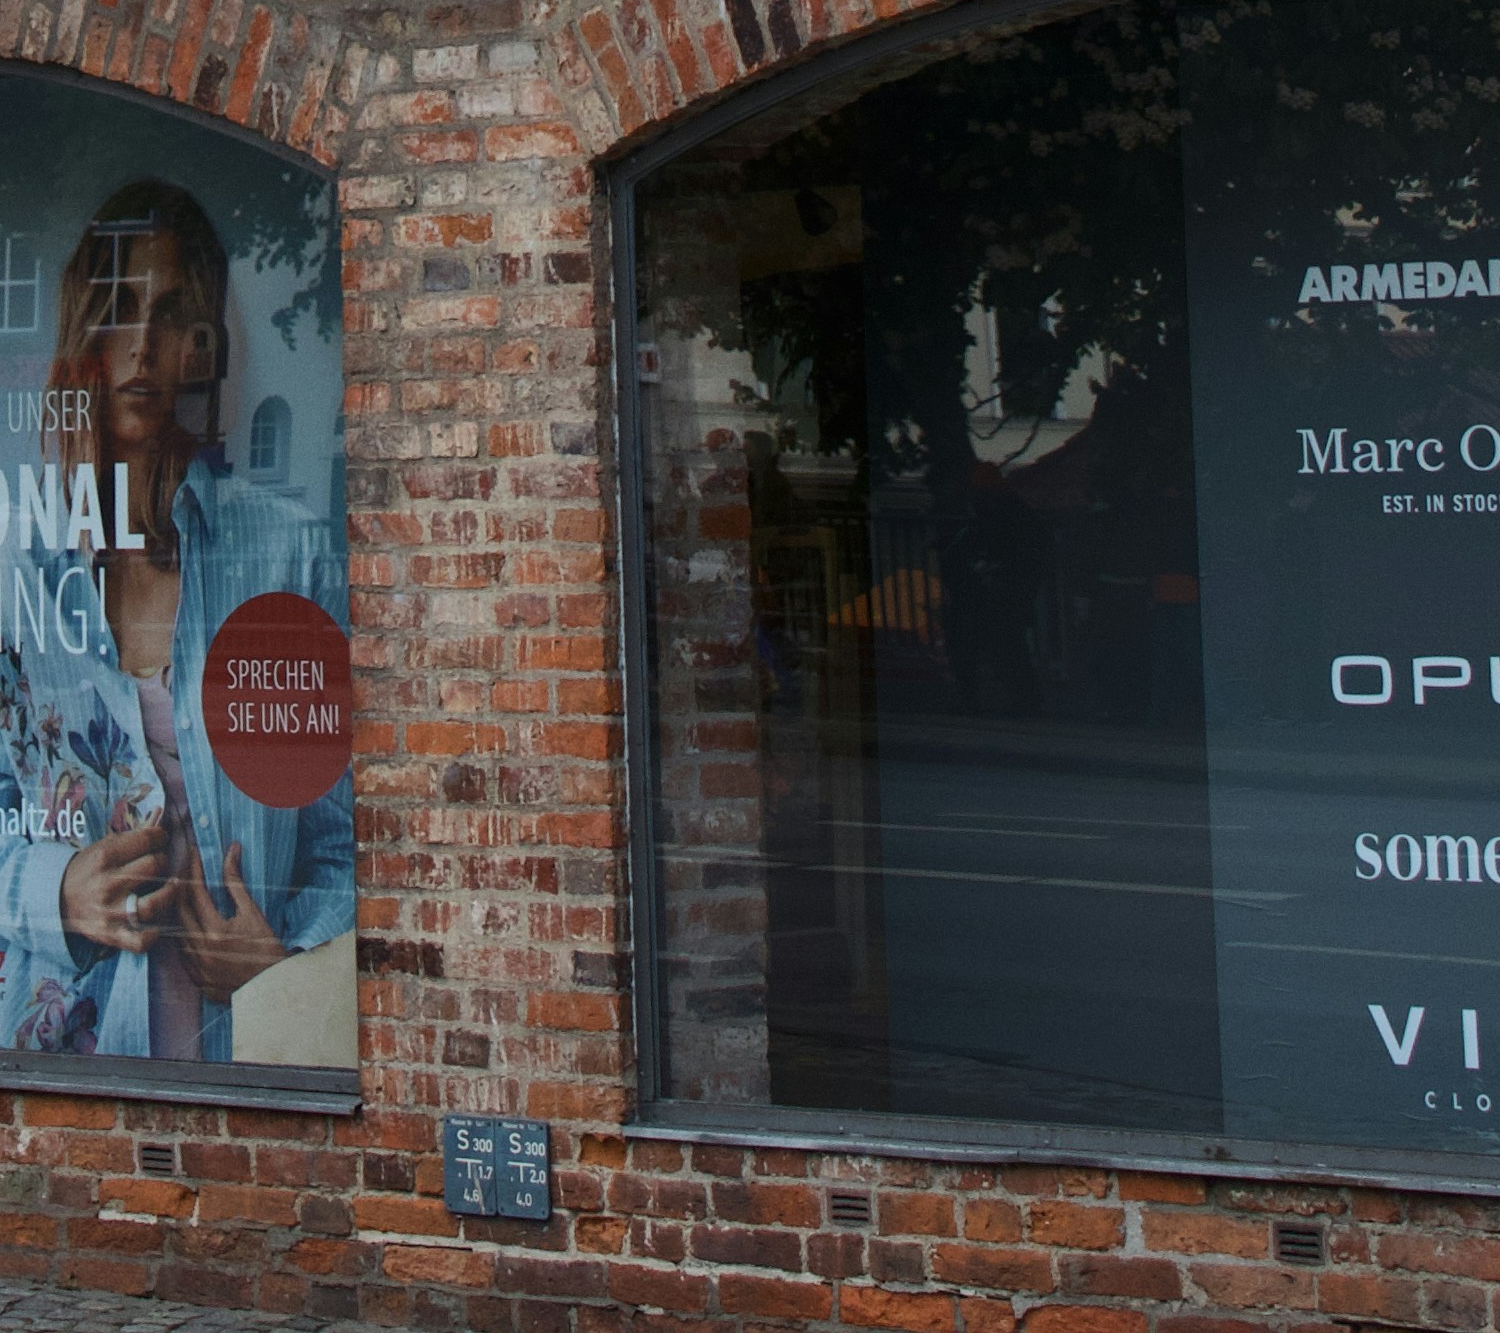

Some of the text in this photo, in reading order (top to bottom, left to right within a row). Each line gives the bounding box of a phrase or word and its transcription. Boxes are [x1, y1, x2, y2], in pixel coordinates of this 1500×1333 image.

[7, 389, 93, 432] UNSER
[1296, 427, 1446, 474] Marc
[1382, 494, 1419, 513] EST.
[1426, 493, 1444, 512] IN
[226, 659, 325, 691] SPRECHEN
[227, 701, 340, 735] SIE UNS AN!
[457, 1129, 493, 1153] S 300
[509, 1133, 546, 1157] S 300
